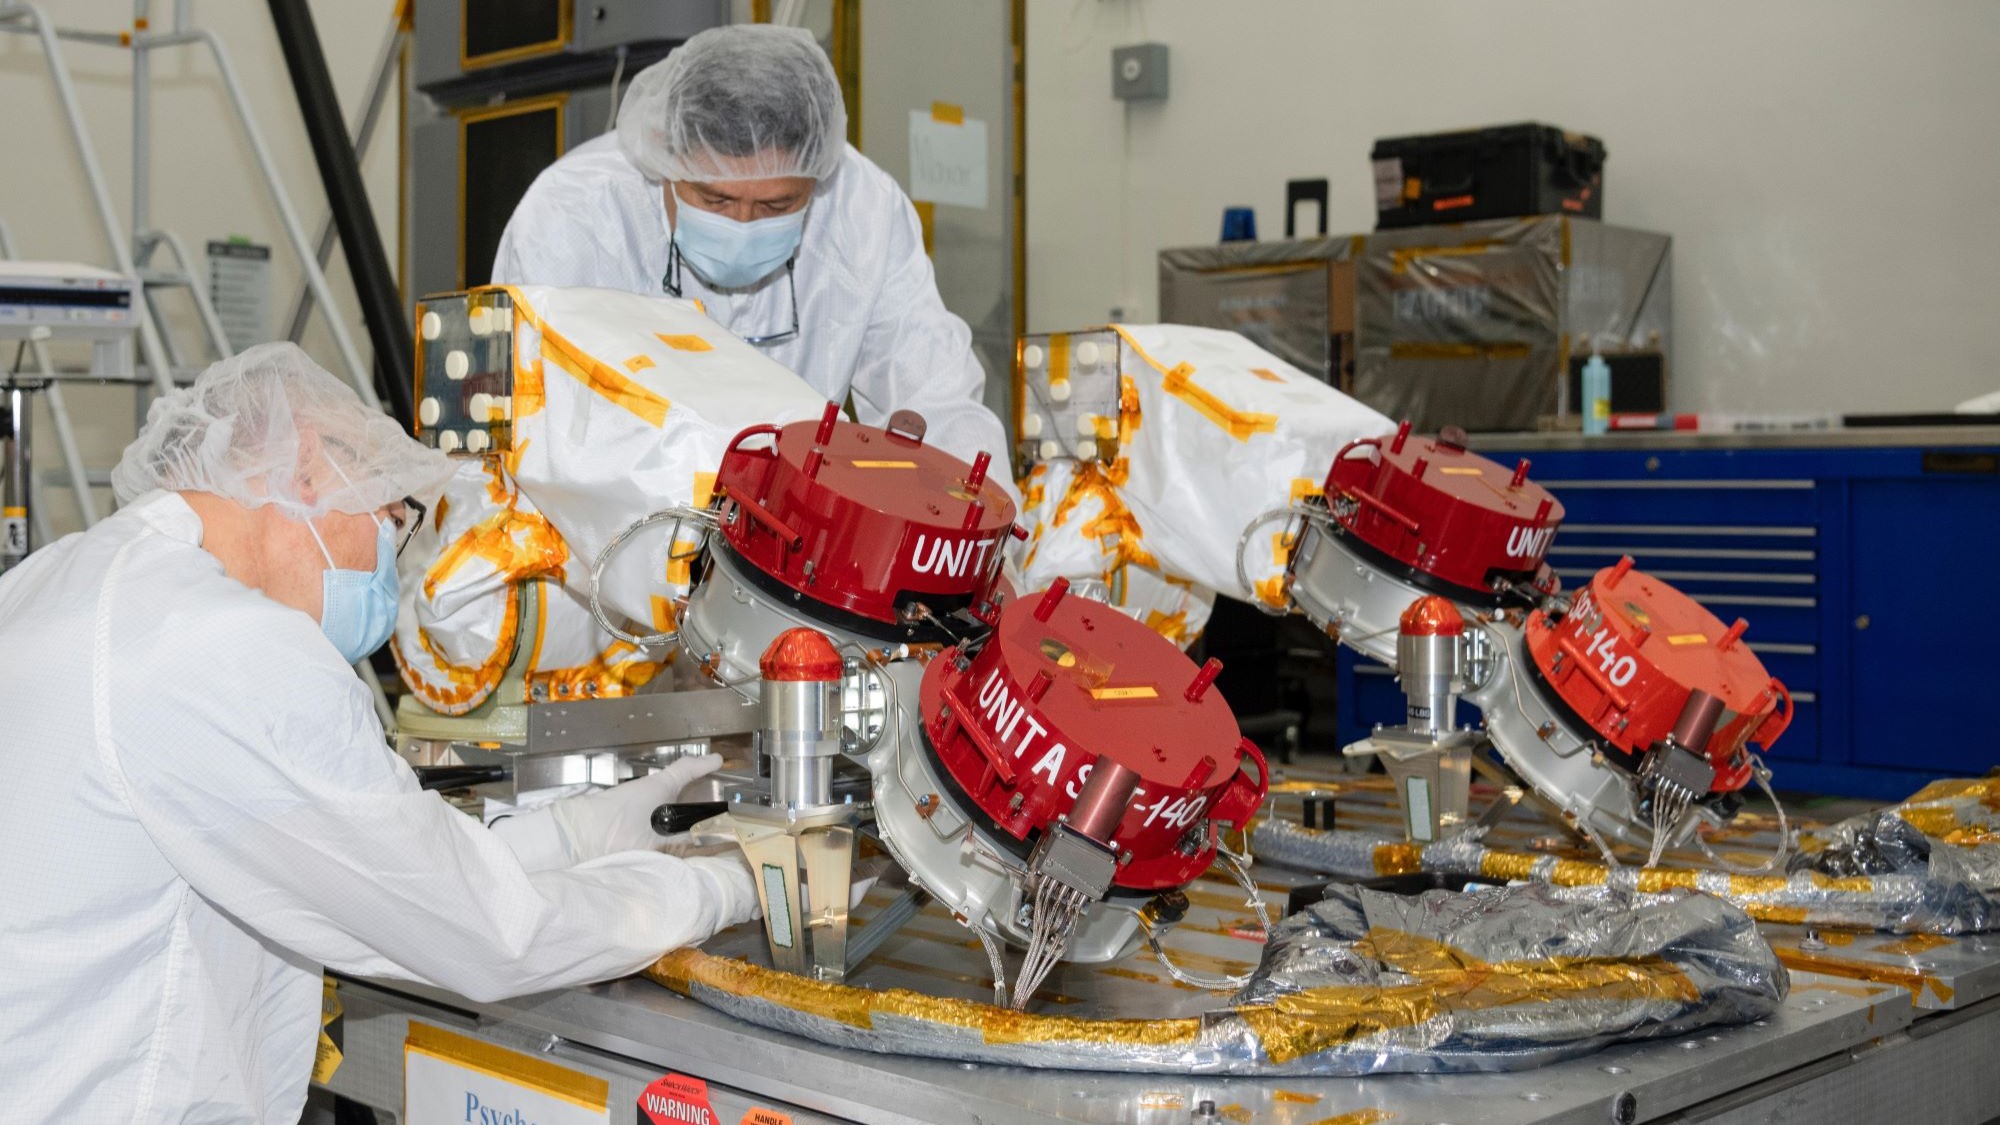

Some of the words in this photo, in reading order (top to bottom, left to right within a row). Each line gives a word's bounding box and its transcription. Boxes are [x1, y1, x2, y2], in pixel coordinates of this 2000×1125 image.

[911, 534, 995, 578] UNIT
[1506, 525, 1555, 558] UNIT
[979, 667, 1048, 759] UNIT
[1031, 742, 1067, 786] A
[1065, 763, 1208, 830] S-140
[465, 1091, 539, 1125] Psych
[646, 1092, 710, 1125] WARNING
[754, 1113, 784, 1125] HANDLE
